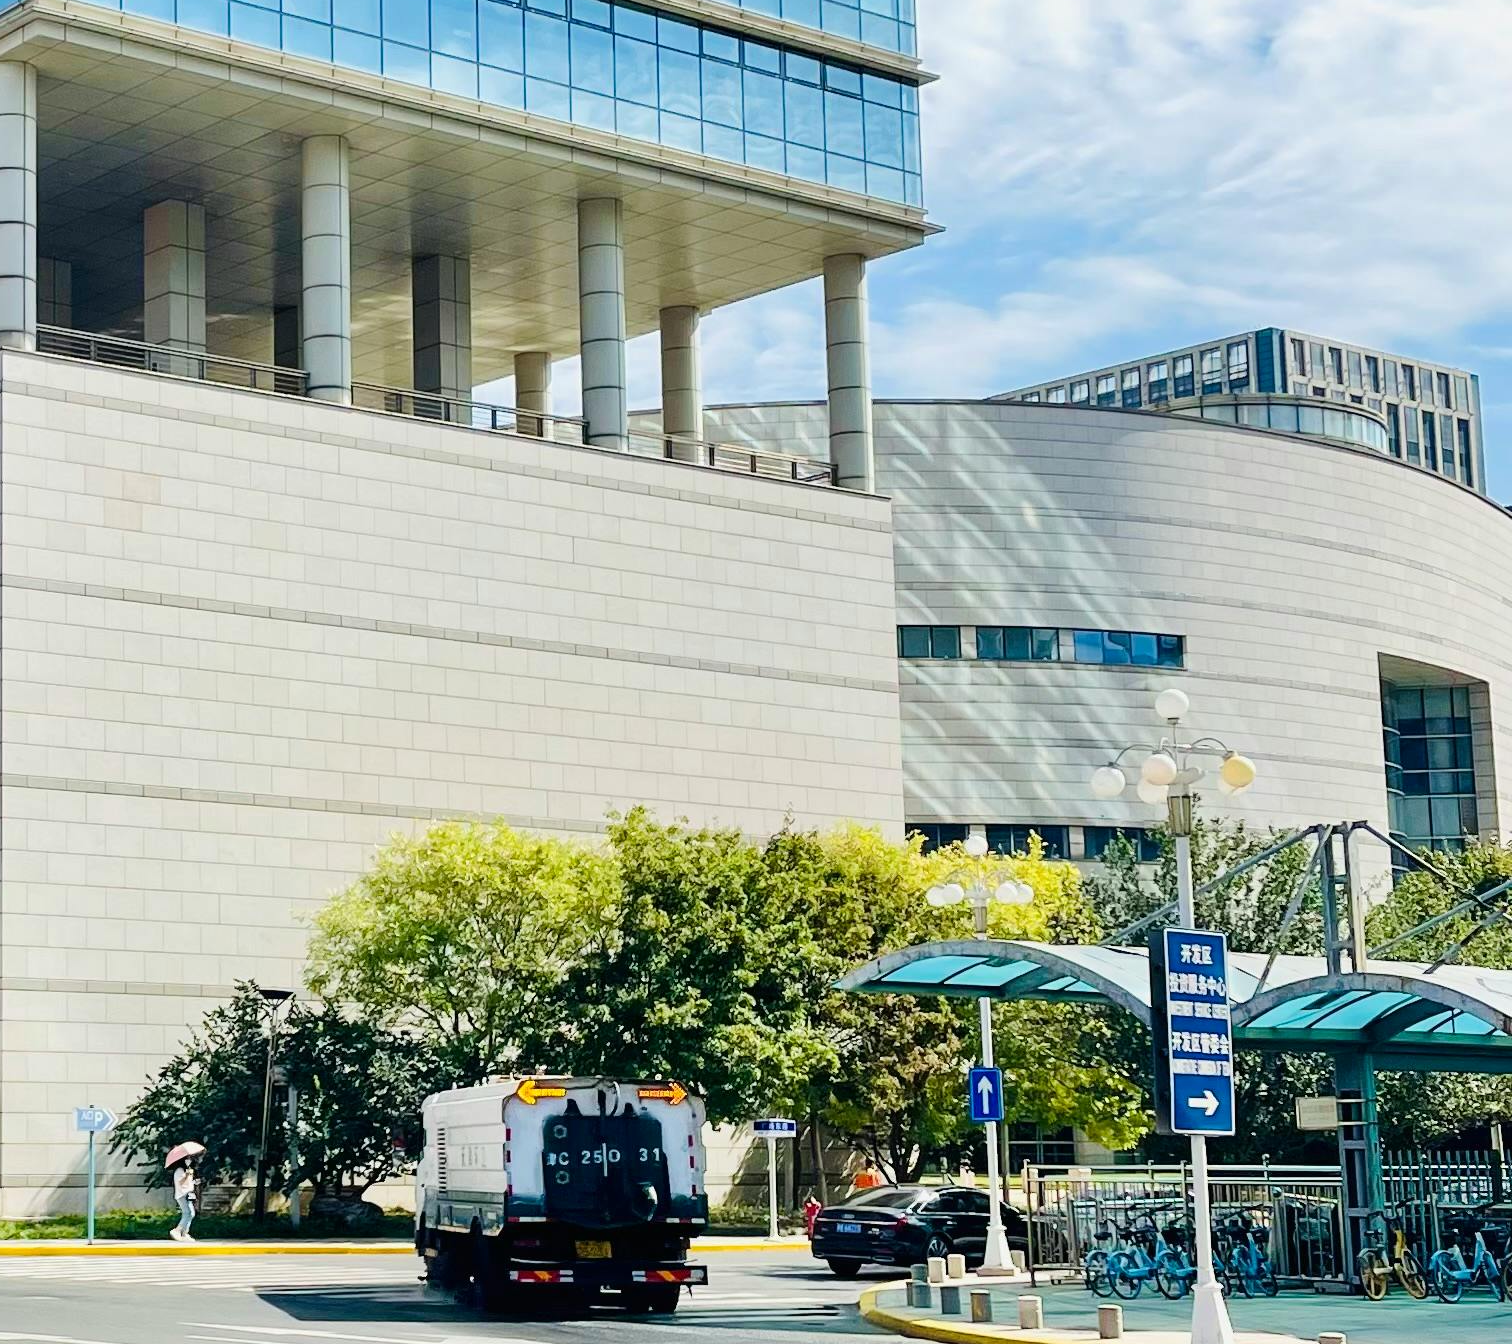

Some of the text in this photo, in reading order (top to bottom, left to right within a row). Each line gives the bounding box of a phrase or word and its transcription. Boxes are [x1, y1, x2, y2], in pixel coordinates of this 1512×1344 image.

[1180, 943, 1214, 965] 开发区
[1169, 971, 1227, 997] 投资服务中心
[1171, 1031, 1230, 1055] 开发区管委会
[94, 1111, 103, 1127] P
